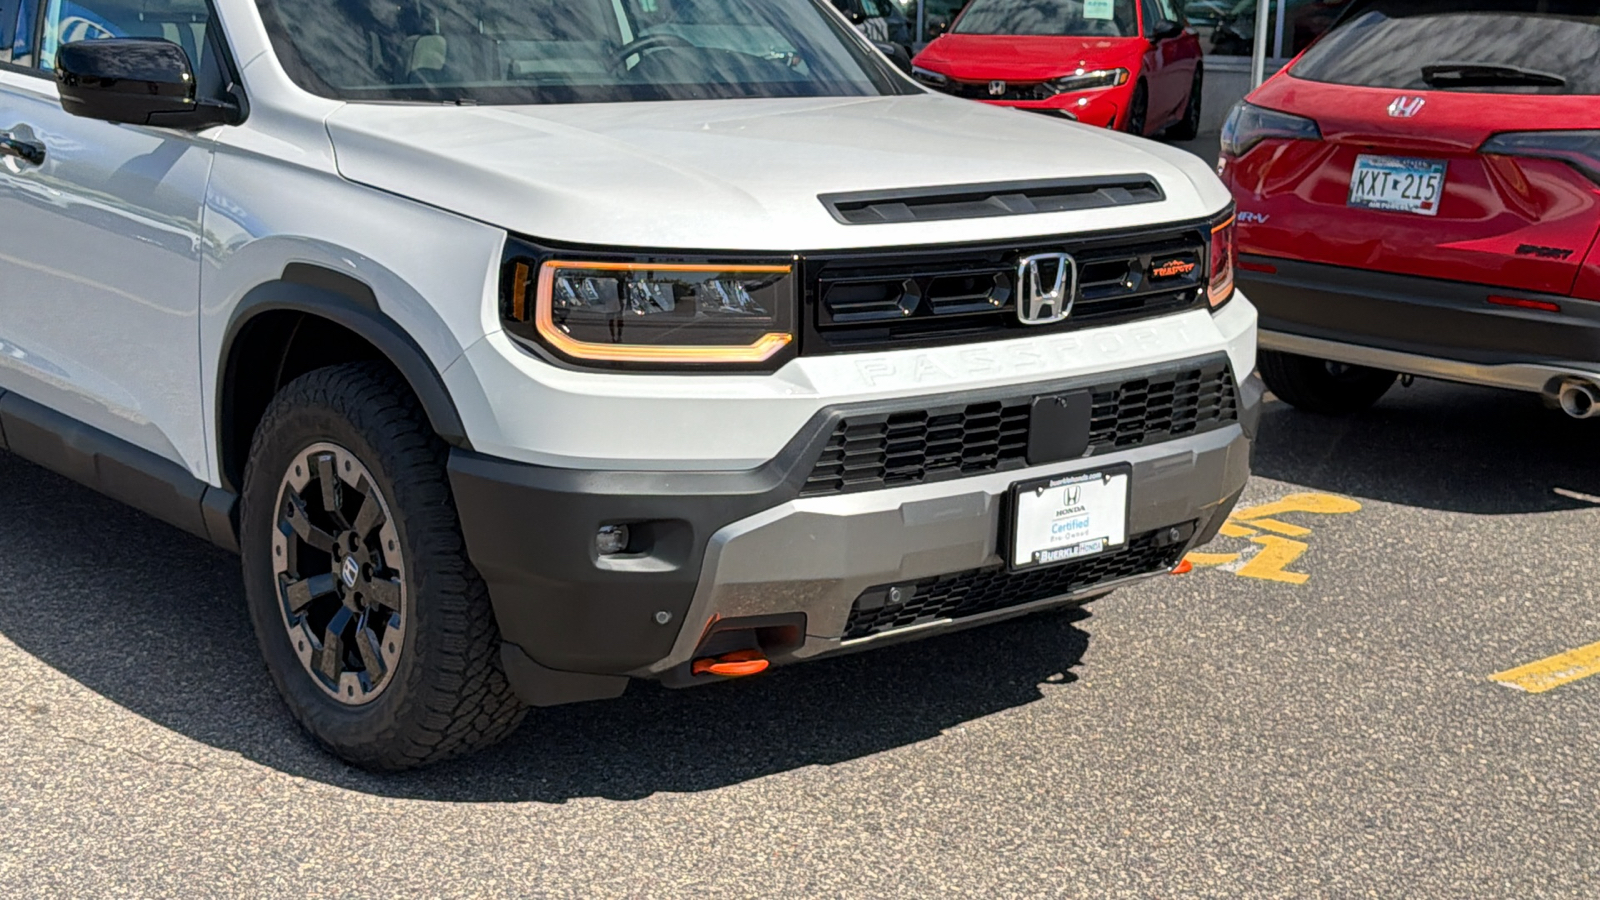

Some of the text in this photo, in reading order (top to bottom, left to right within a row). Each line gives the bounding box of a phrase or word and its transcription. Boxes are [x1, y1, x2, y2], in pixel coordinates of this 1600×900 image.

[1356, 170, 1439, 202] KXT 215
[857, 319, 1196, 386] PASSPORT
[1056, 505, 1085, 516] HONDA
[1051, 518, 1090, 533] Certified
[1050, 531, 1090, 541] Pre-Owned
[1040, 541, 1102, 563] BUERKLE HONDA
